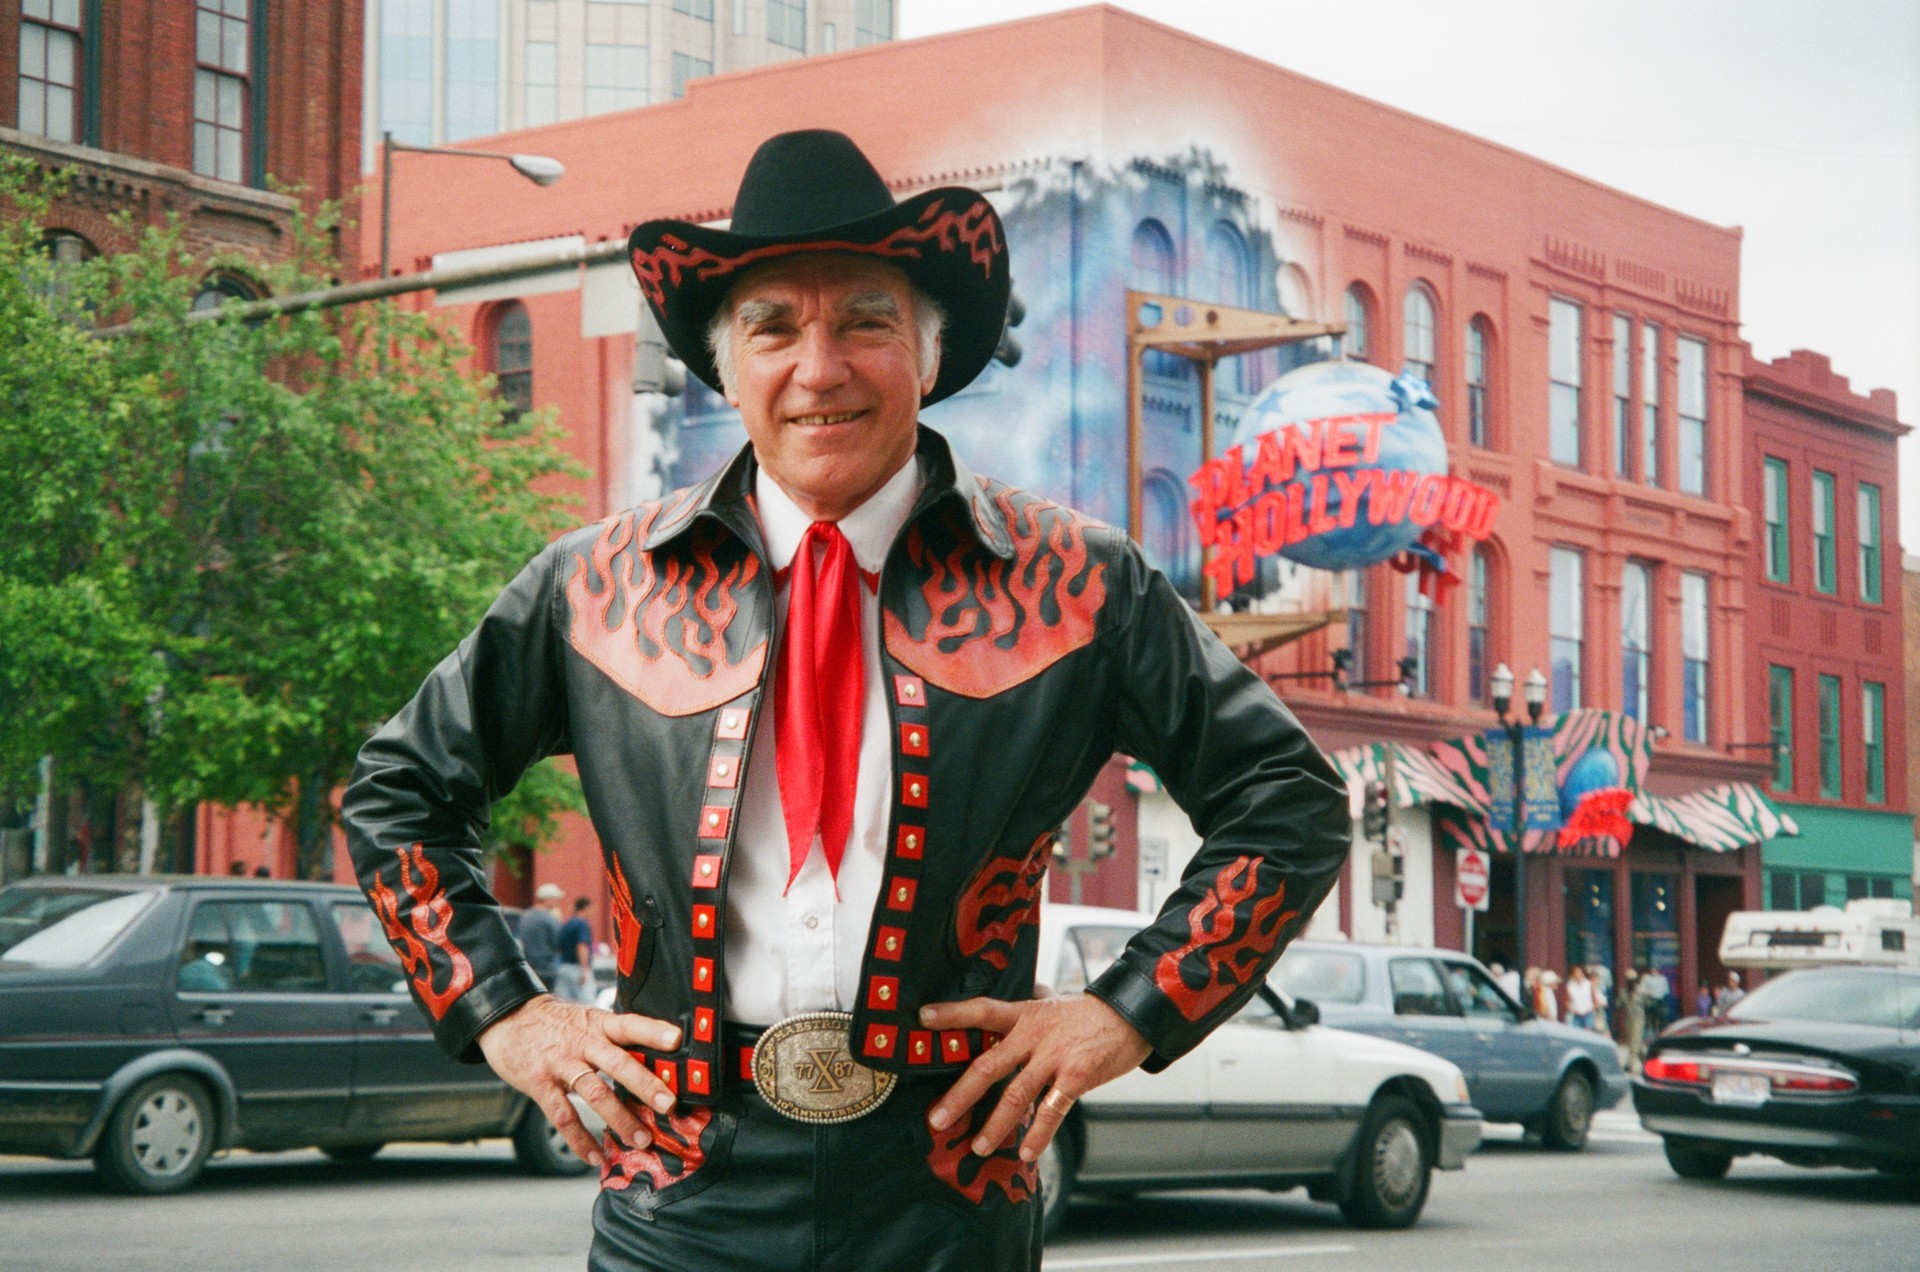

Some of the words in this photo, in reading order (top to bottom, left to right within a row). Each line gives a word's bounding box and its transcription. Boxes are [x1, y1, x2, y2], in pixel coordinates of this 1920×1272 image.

[1188, 412, 1397, 510] PLANET
[1202, 467, 1501, 600] HOLLYWOOD
[794, 1063, 814, 1079] 77
[806, 1049, 844, 1092] X
[834, 1061, 854, 1078] 87
[791, 1094, 876, 1118] ANNIVERSARY
